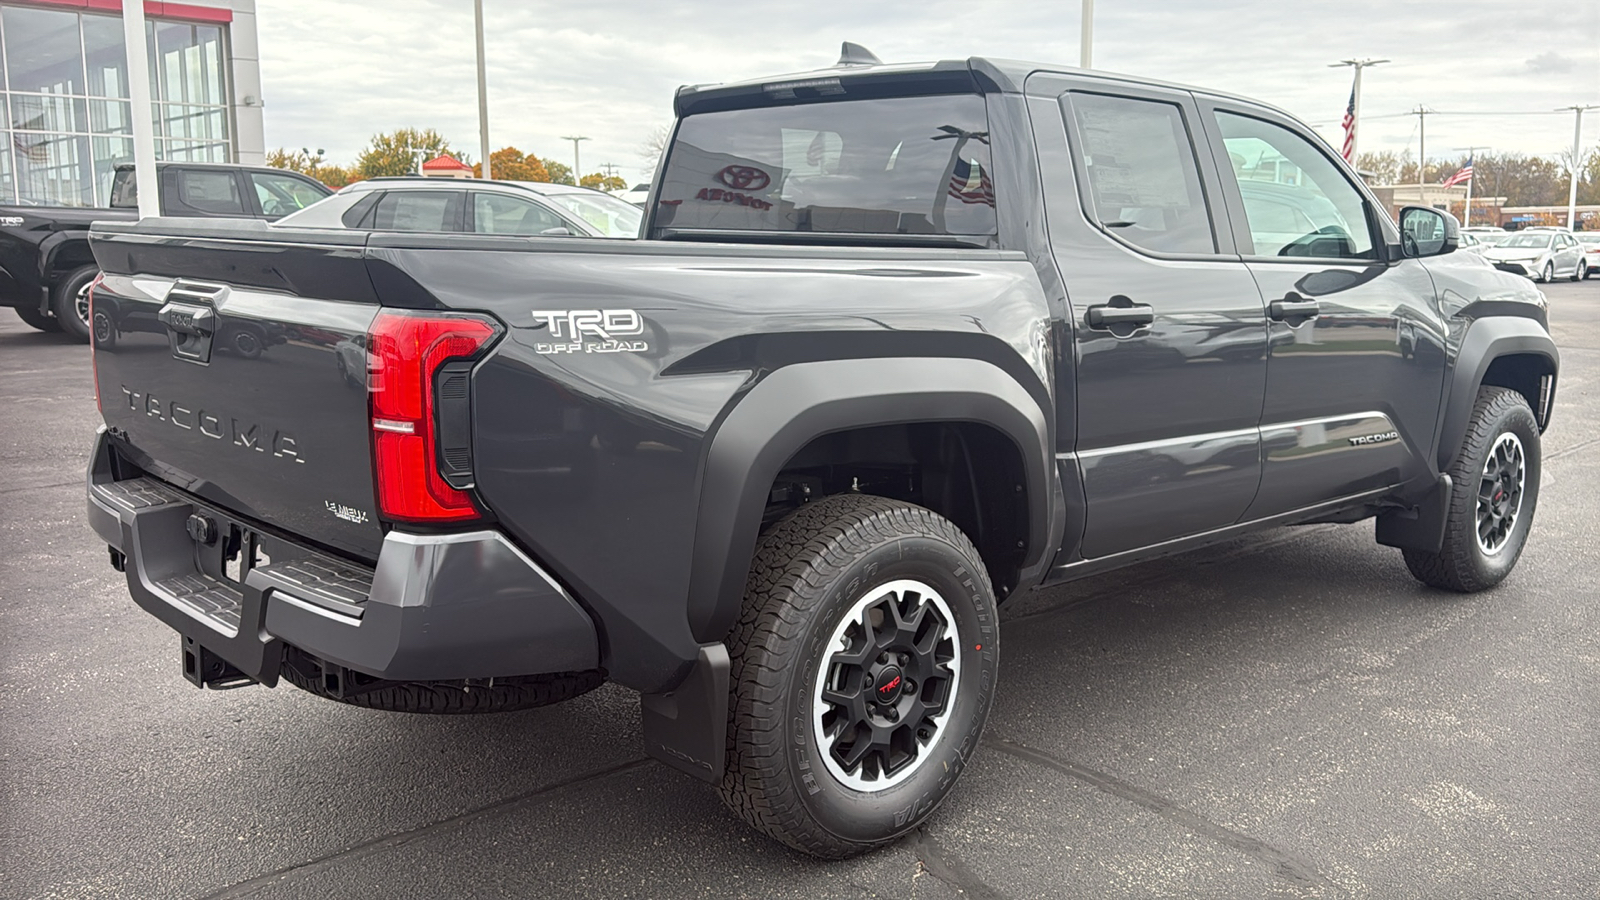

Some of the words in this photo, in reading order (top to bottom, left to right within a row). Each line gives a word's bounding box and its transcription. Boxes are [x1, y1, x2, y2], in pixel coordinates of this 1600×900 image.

[531, 309, 644, 343] TRD
[534, 342, 582, 354] OFF
[584, 340, 649, 353] ROAD
[121, 384, 306, 464] TACOMA
[1348, 431, 1398, 446] TACOMA
[879, 675, 901, 693] TRD
